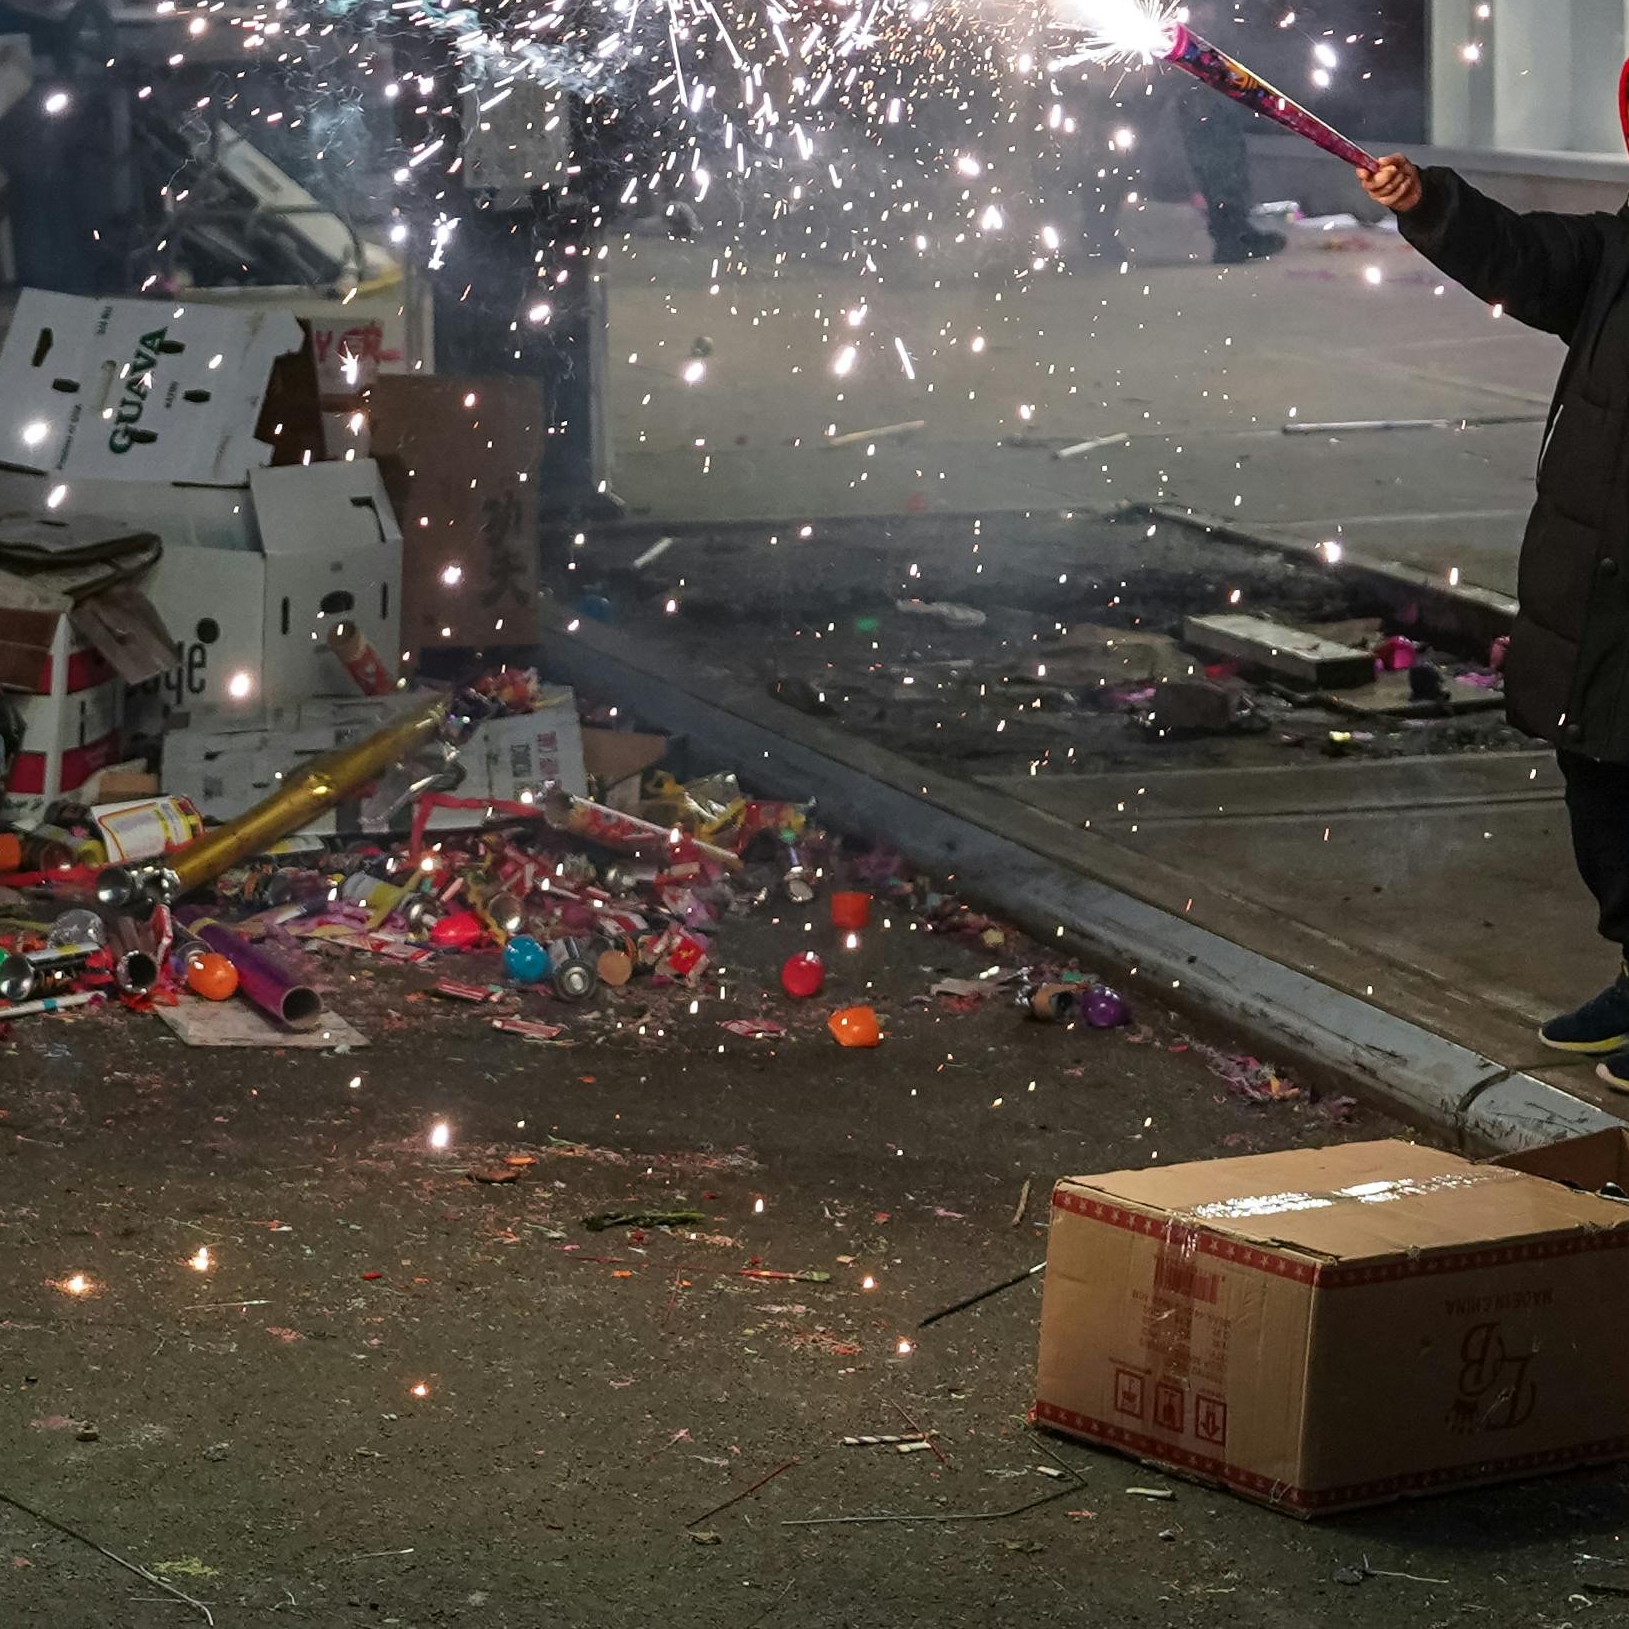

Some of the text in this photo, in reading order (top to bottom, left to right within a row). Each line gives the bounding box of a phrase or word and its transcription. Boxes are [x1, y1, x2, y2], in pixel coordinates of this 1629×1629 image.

[109, 326, 169, 454] GUAVA
[1444, 1296, 1494, 1316] CHINA
[1512, 1288, 1553, 1308] MADE
